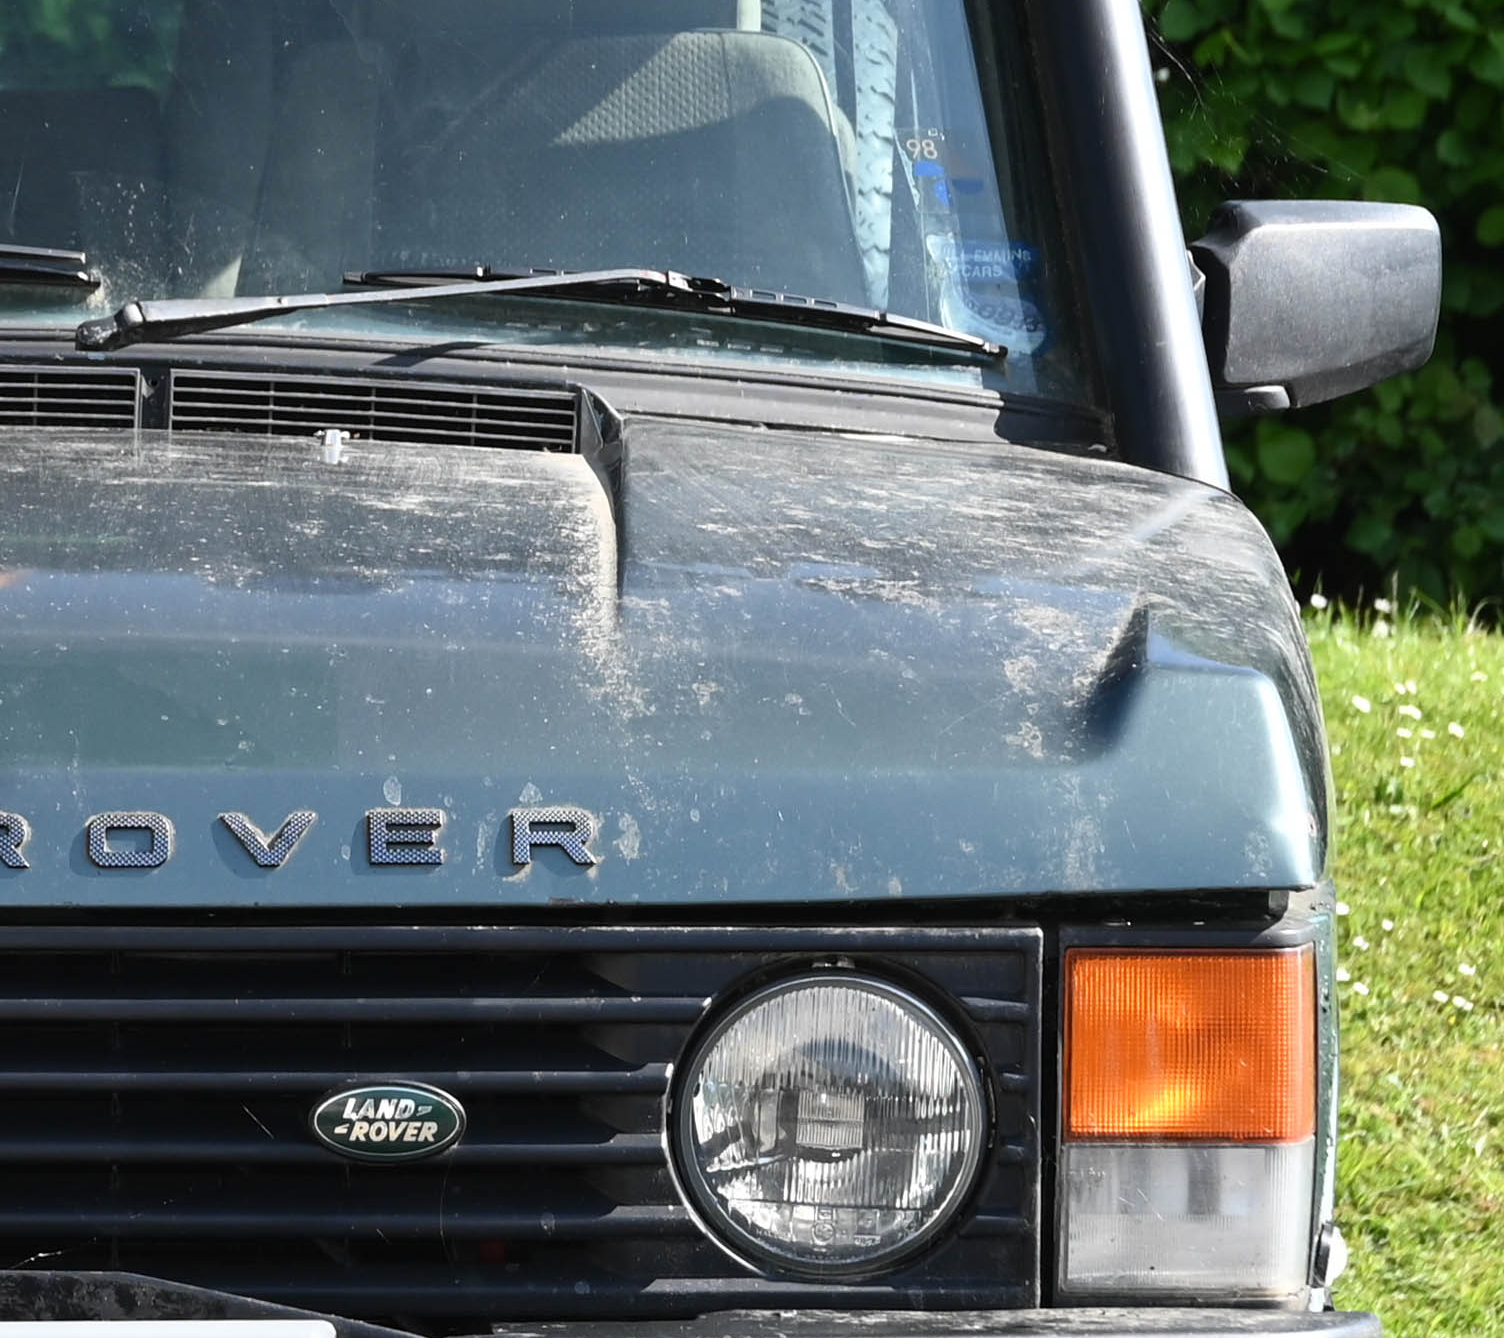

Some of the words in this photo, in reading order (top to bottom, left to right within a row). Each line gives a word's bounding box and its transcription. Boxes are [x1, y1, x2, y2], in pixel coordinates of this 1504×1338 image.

[906, 139, 938, 159] 98
[342, 1097, 416, 1120] LAND
[348, 1120, 439, 1143] ROVER
